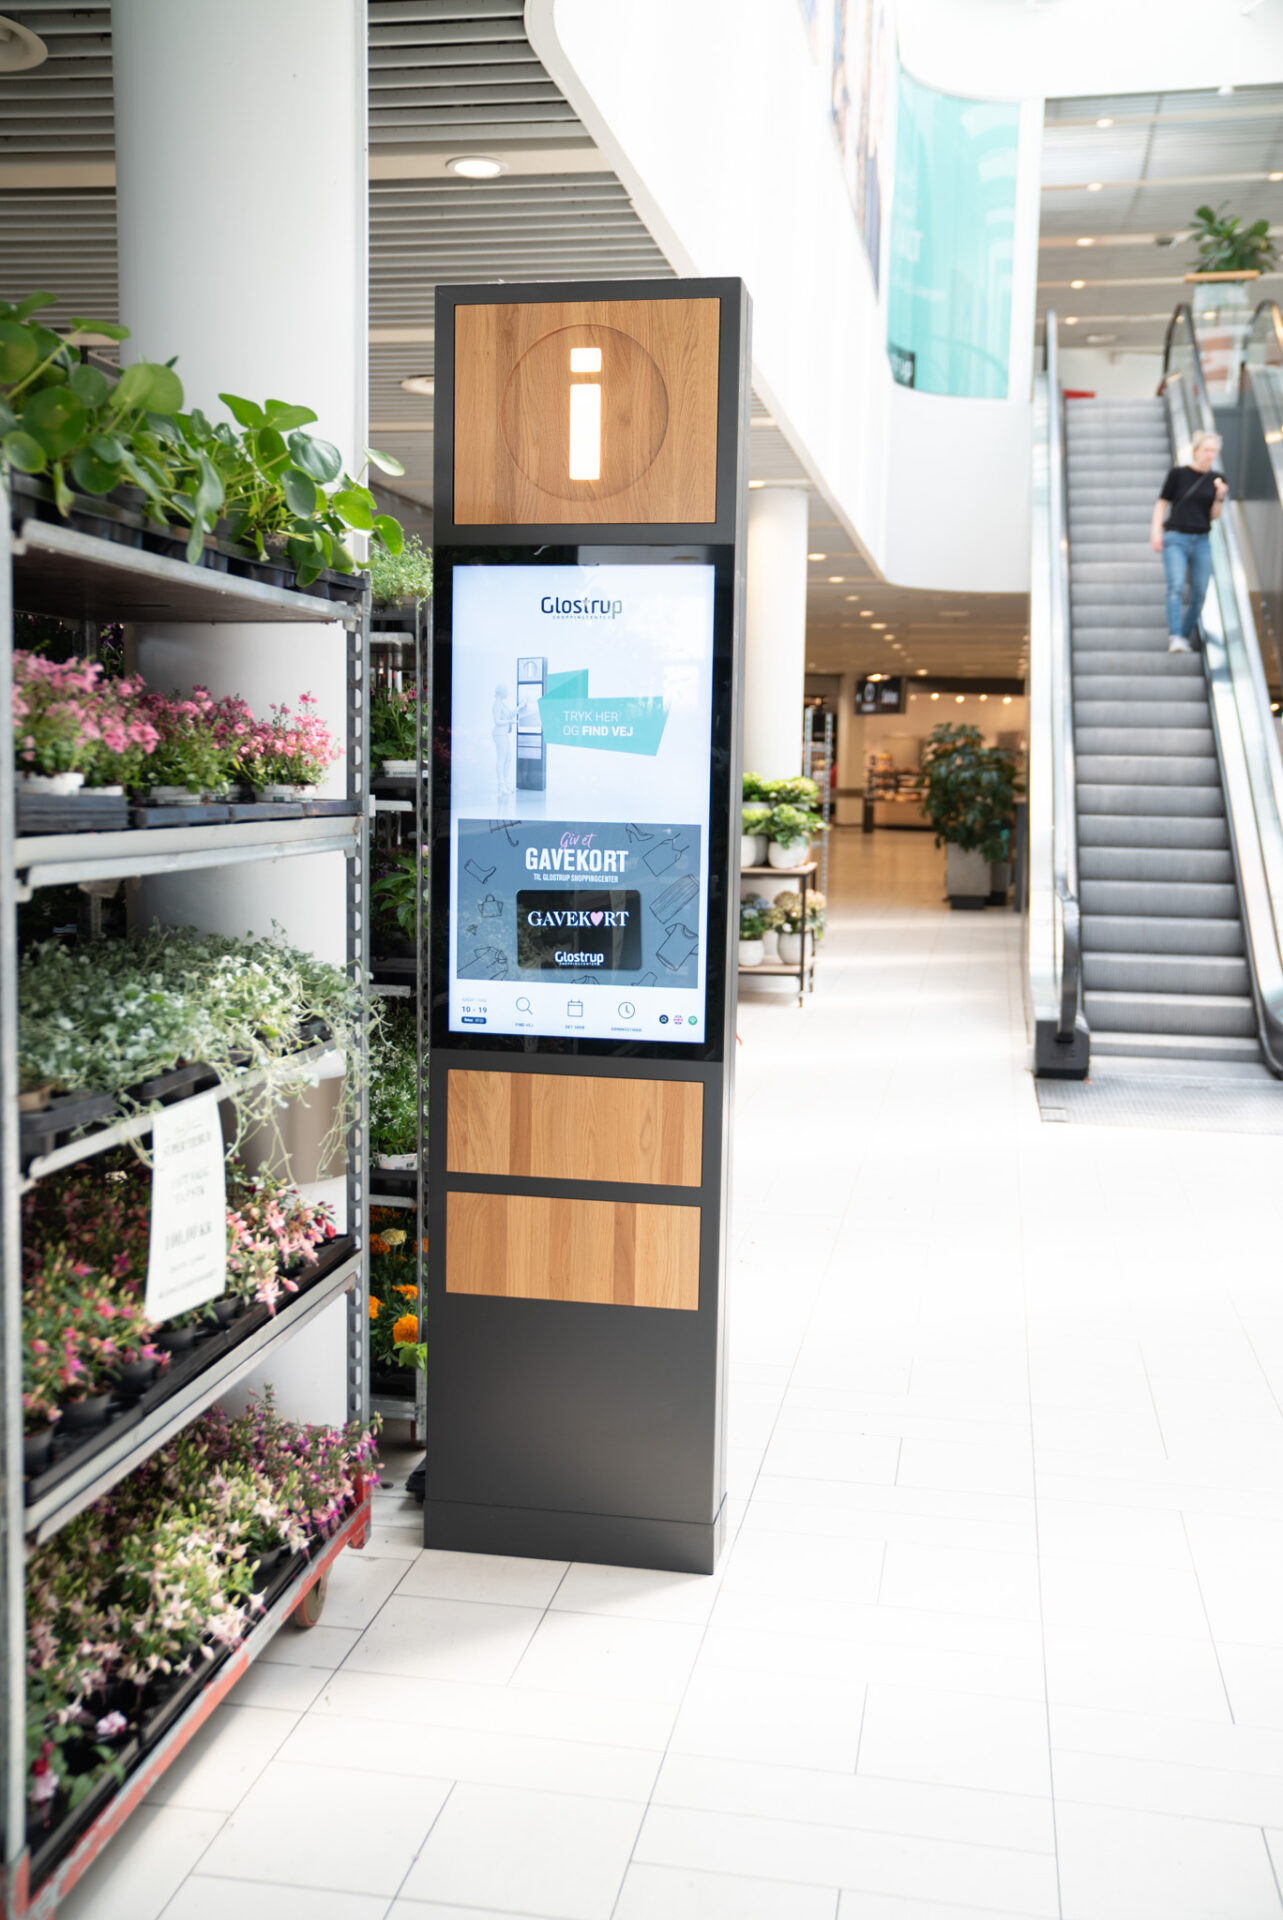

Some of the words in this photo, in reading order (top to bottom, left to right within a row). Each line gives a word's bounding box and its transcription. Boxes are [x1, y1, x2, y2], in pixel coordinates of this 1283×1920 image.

[541, 596, 623, 619] Glostrup
[563, 711, 593, 722] TRYK
[595, 711, 619, 722] HER
[563, 725, 580, 736] OG
[582, 726, 609, 737] FIND
[611, 726, 634, 737] VEJ
[559, 831, 580, 850] Giv
[581, 832, 597, 849] et
[525, 847, 629, 873] GAVEKORT
[533, 872, 542, 881] TIL
[542, 873, 570, 882] GLOSTRUP
[571, 874, 619, 884] SHOPPINGCENTER
[554, 951, 604, 966] Glostrup
